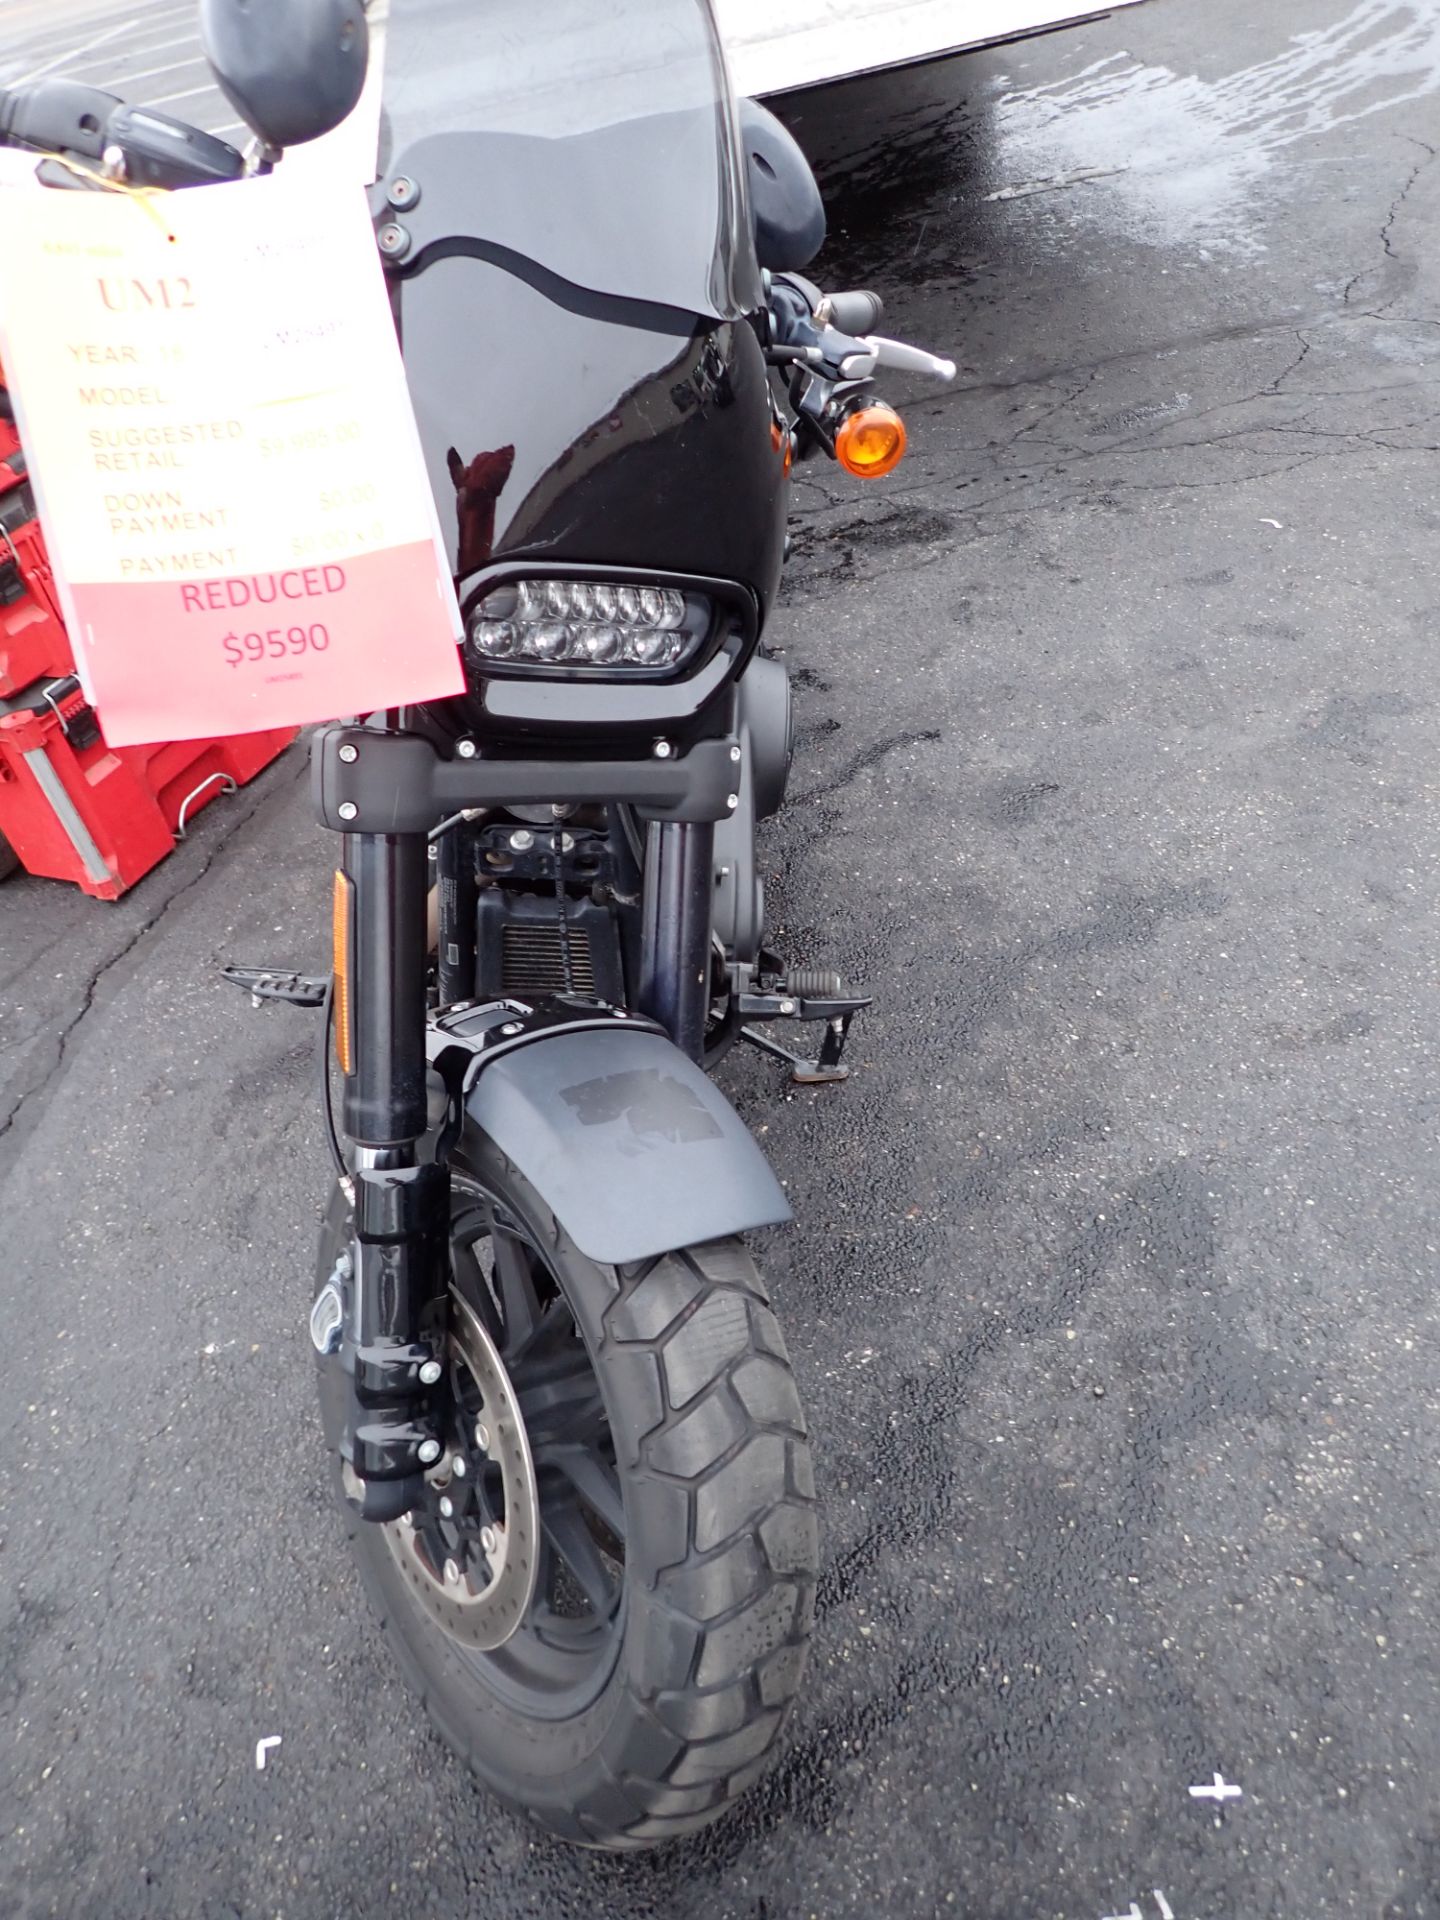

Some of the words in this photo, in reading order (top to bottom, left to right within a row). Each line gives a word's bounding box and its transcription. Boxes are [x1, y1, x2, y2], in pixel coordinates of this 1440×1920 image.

[97, 276, 194, 310] UM2
[88, 420, 243, 449] SUGGESTED
[104, 491, 182, 512] DOWN
[180, 565, 347, 612] REDUCED
[222, 623, 329, 668] $9590
